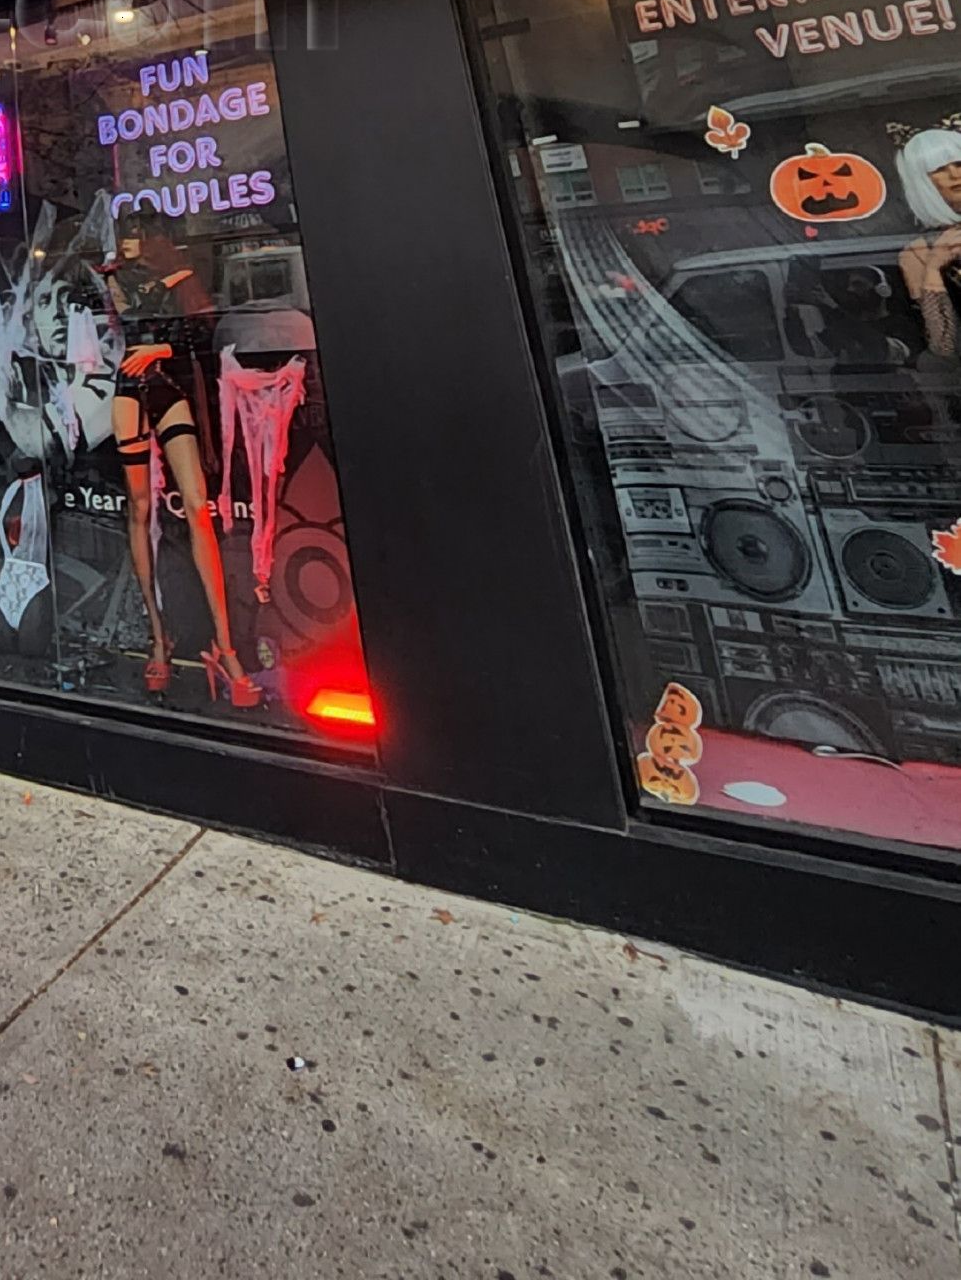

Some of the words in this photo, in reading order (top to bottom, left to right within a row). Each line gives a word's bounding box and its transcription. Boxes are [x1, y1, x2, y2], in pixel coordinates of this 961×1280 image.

[139, 53, 209, 97] FUN
[98, 81, 270, 145] BONDAGE
[149, 136, 222, 177] FOR
[79, 486, 127, 511] Year
